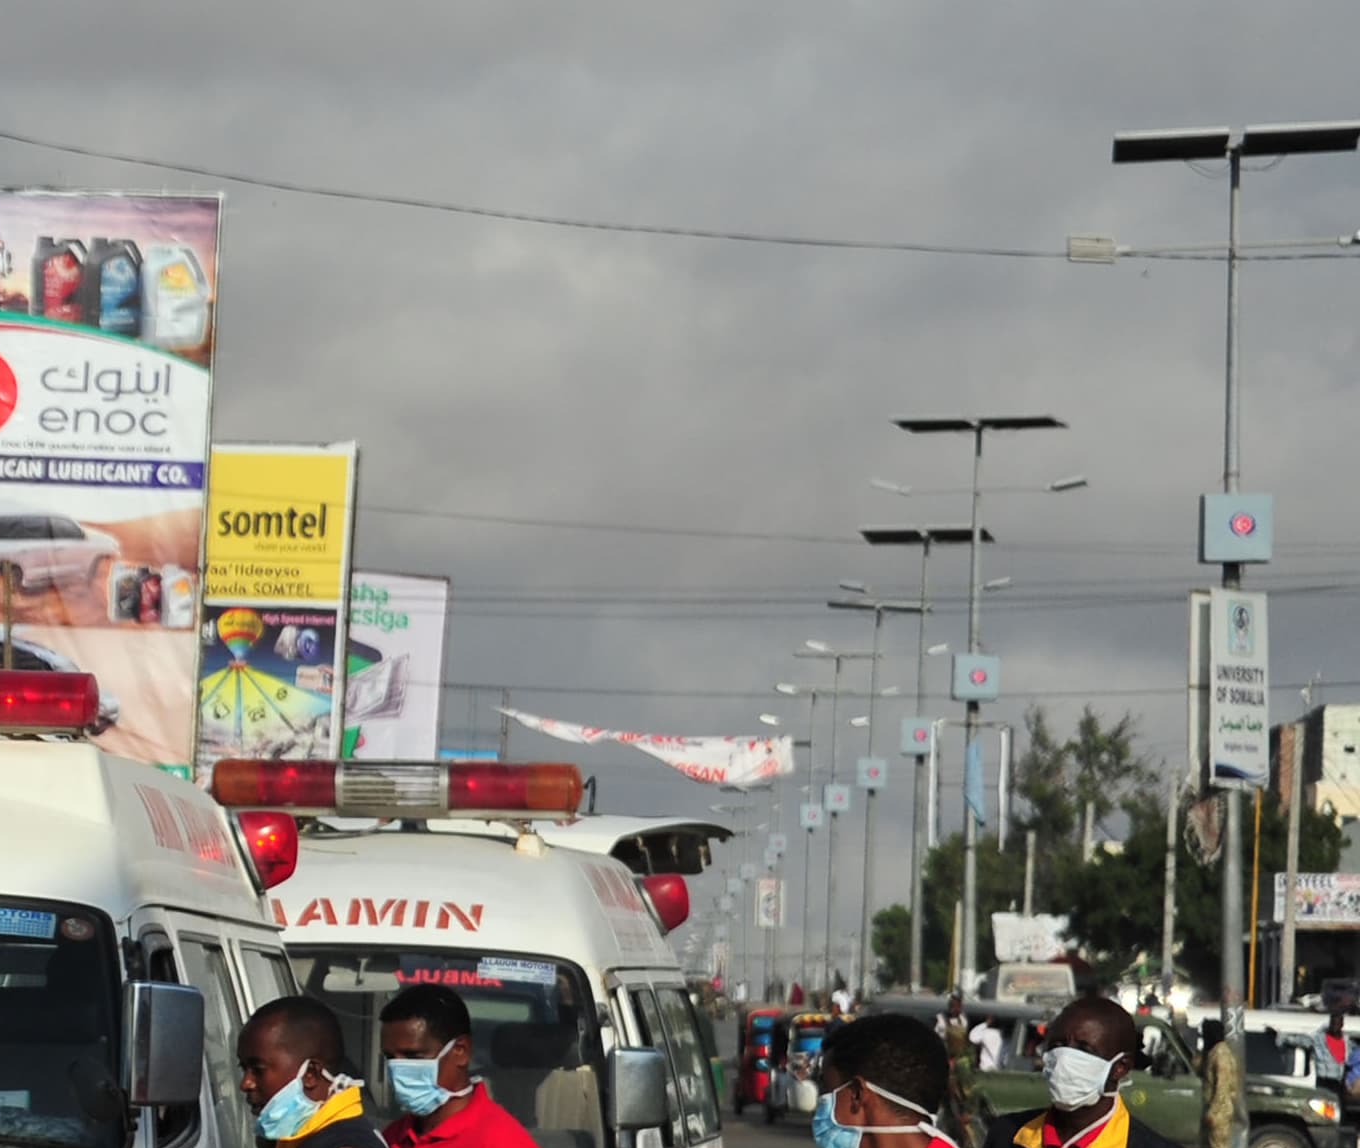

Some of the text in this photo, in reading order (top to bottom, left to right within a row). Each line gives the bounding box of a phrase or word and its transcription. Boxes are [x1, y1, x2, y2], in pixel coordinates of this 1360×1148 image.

[38, 406, 168, 437] enoc
[48, 459, 153, 482] LUBRICANT
[156, 465, 188, 484] CO.
[217, 503, 327, 538] somtel
[253, 582, 313, 598] SOMTEL
[1216, 664, 1265, 683] UNIVERSITY
[1216, 686, 1226, 704] OF
